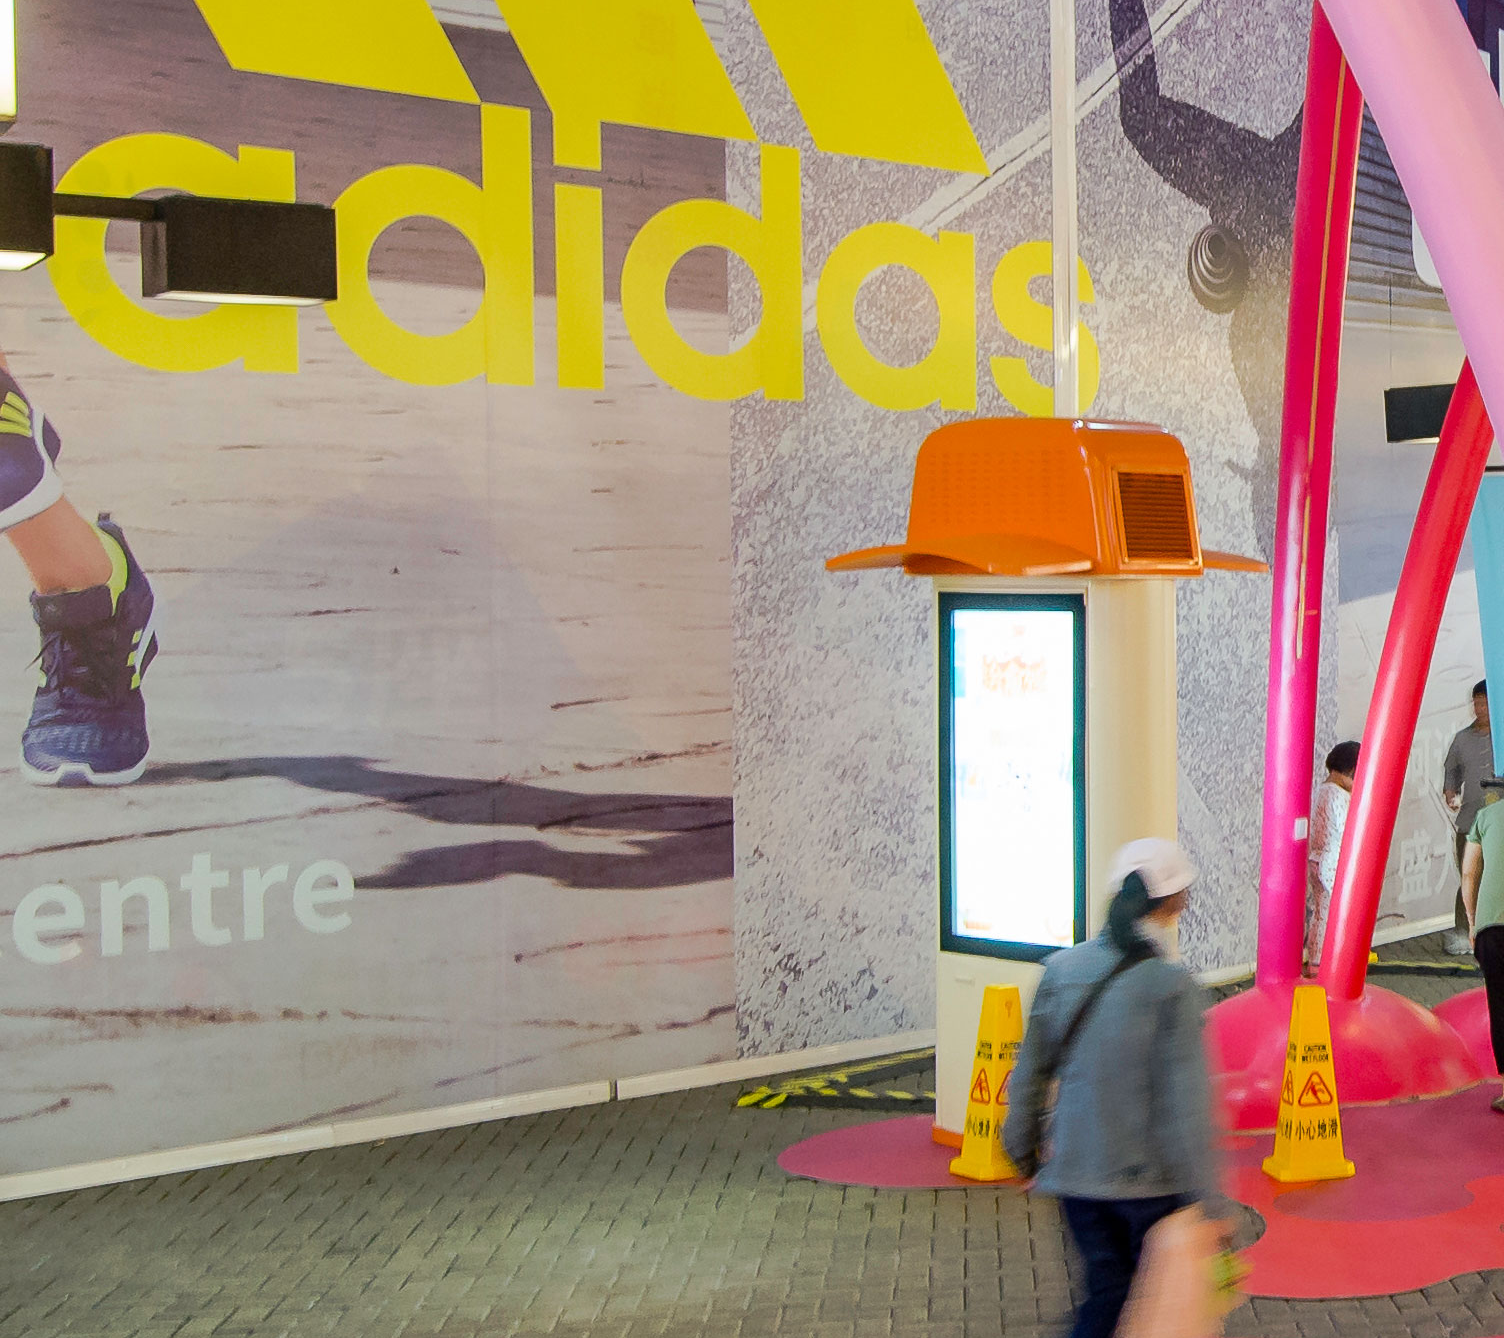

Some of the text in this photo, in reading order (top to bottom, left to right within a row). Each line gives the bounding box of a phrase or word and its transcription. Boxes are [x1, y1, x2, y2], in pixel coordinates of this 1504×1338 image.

[48, 101, 1102, 418] adidas
[1295, 1117, 1338, 1141] 小心地滑
